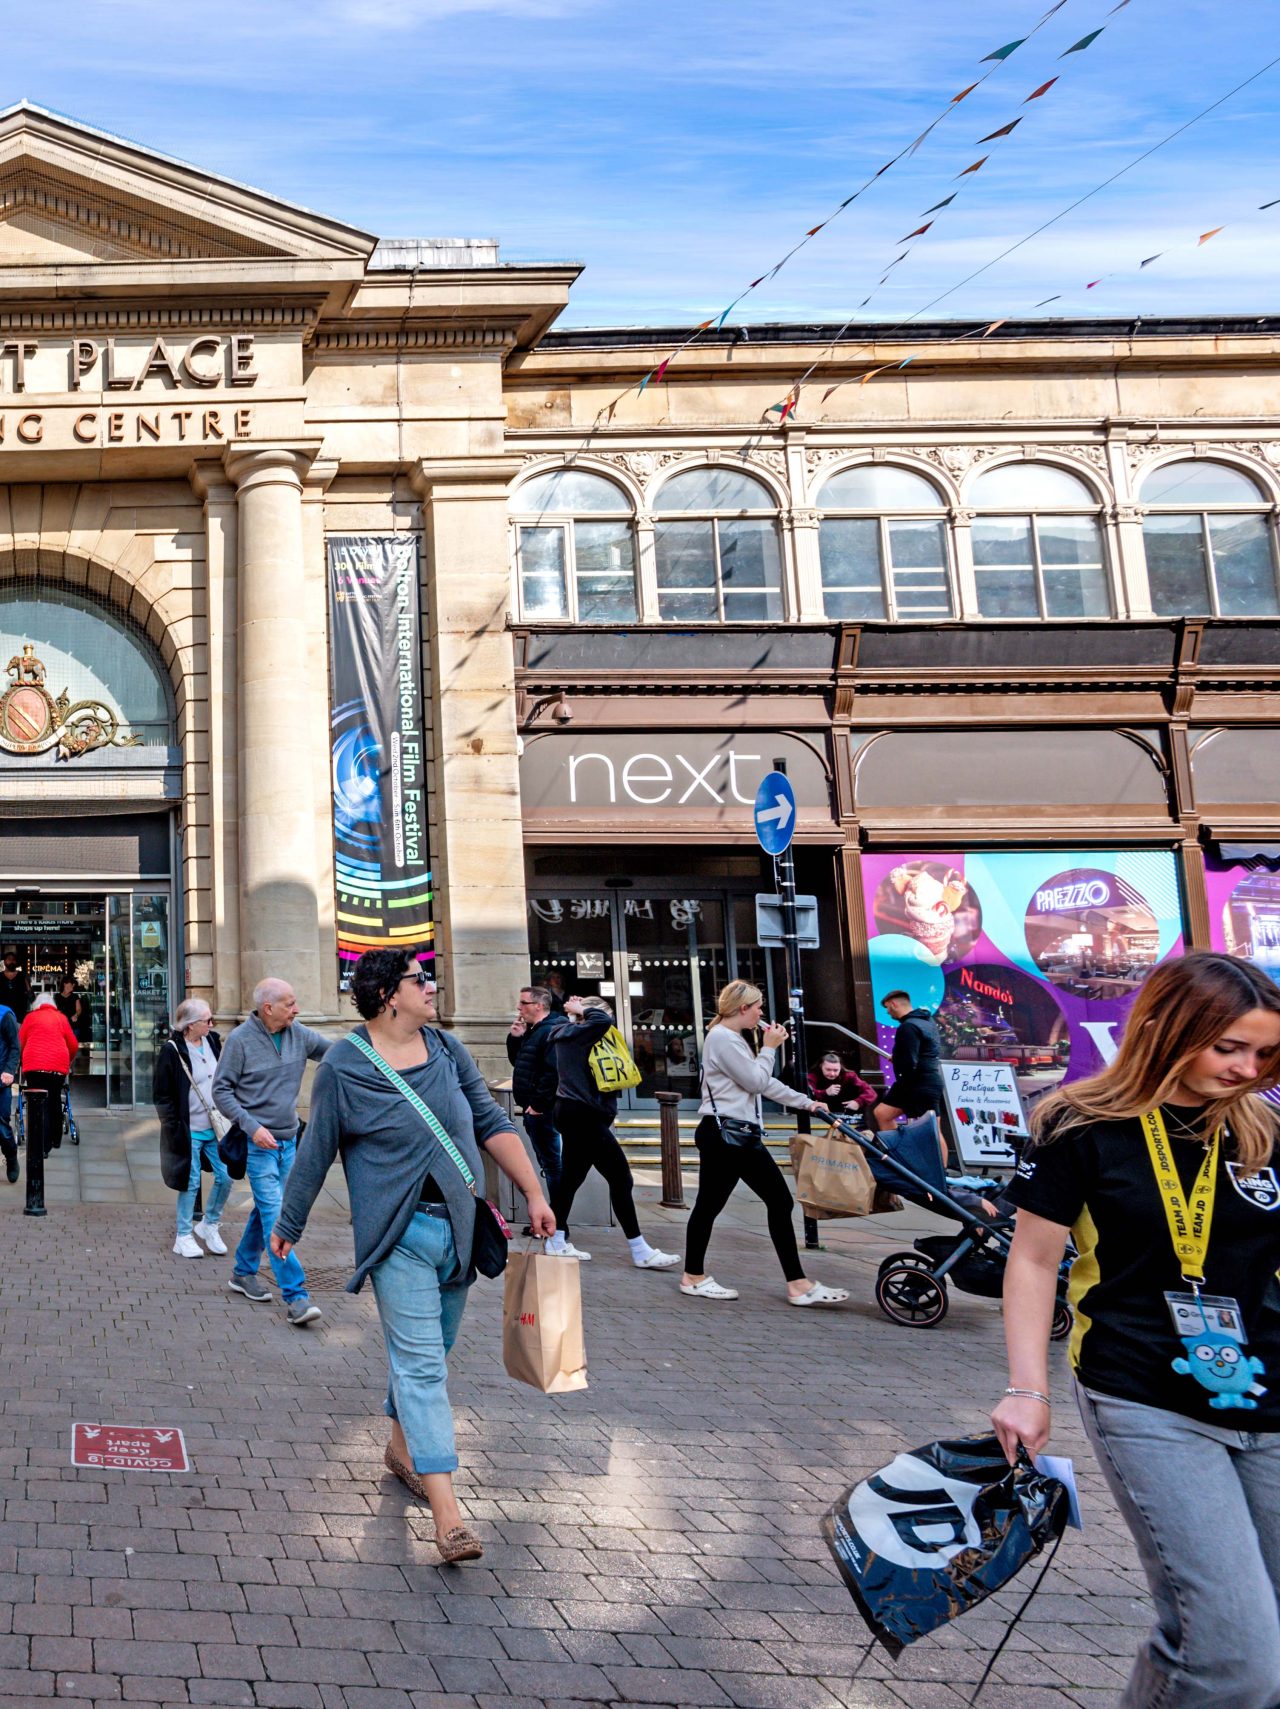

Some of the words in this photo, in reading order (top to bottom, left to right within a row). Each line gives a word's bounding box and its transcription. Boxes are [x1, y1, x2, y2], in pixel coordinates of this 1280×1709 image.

[73, 334, 258, 390] PLACE
[74, 409, 252, 441] CENTRE
[398, 613, 418, 735] International
[401, 742, 420, 782] Film
[569, 750, 761, 805] next
[403, 788, 424, 865] Festival
[1036, 880, 1109, 912] PREZZO
[960, 967, 1014, 1005] Nando's
[597, 1057, 628, 1082] ER
[962, 1081, 995, 1096] Boutique
[1146, 1111, 1170, 1173] JDSPORTS.CO
[810, 1155, 858, 1171] PRIMARK
[1170, 1196, 1181, 1208] JD
[1196, 1200, 1205, 1211] JD
[1173, 1210, 1187, 1237] TEAM
[1193, 1212, 1204, 1238] TEAM
[1190, 1311, 1214, 1320] Grup
[106, 1439, 151, 1447] apart
[88, 1455, 171, 1467] COVID-19
[867, 1474, 967, 1553] JD
